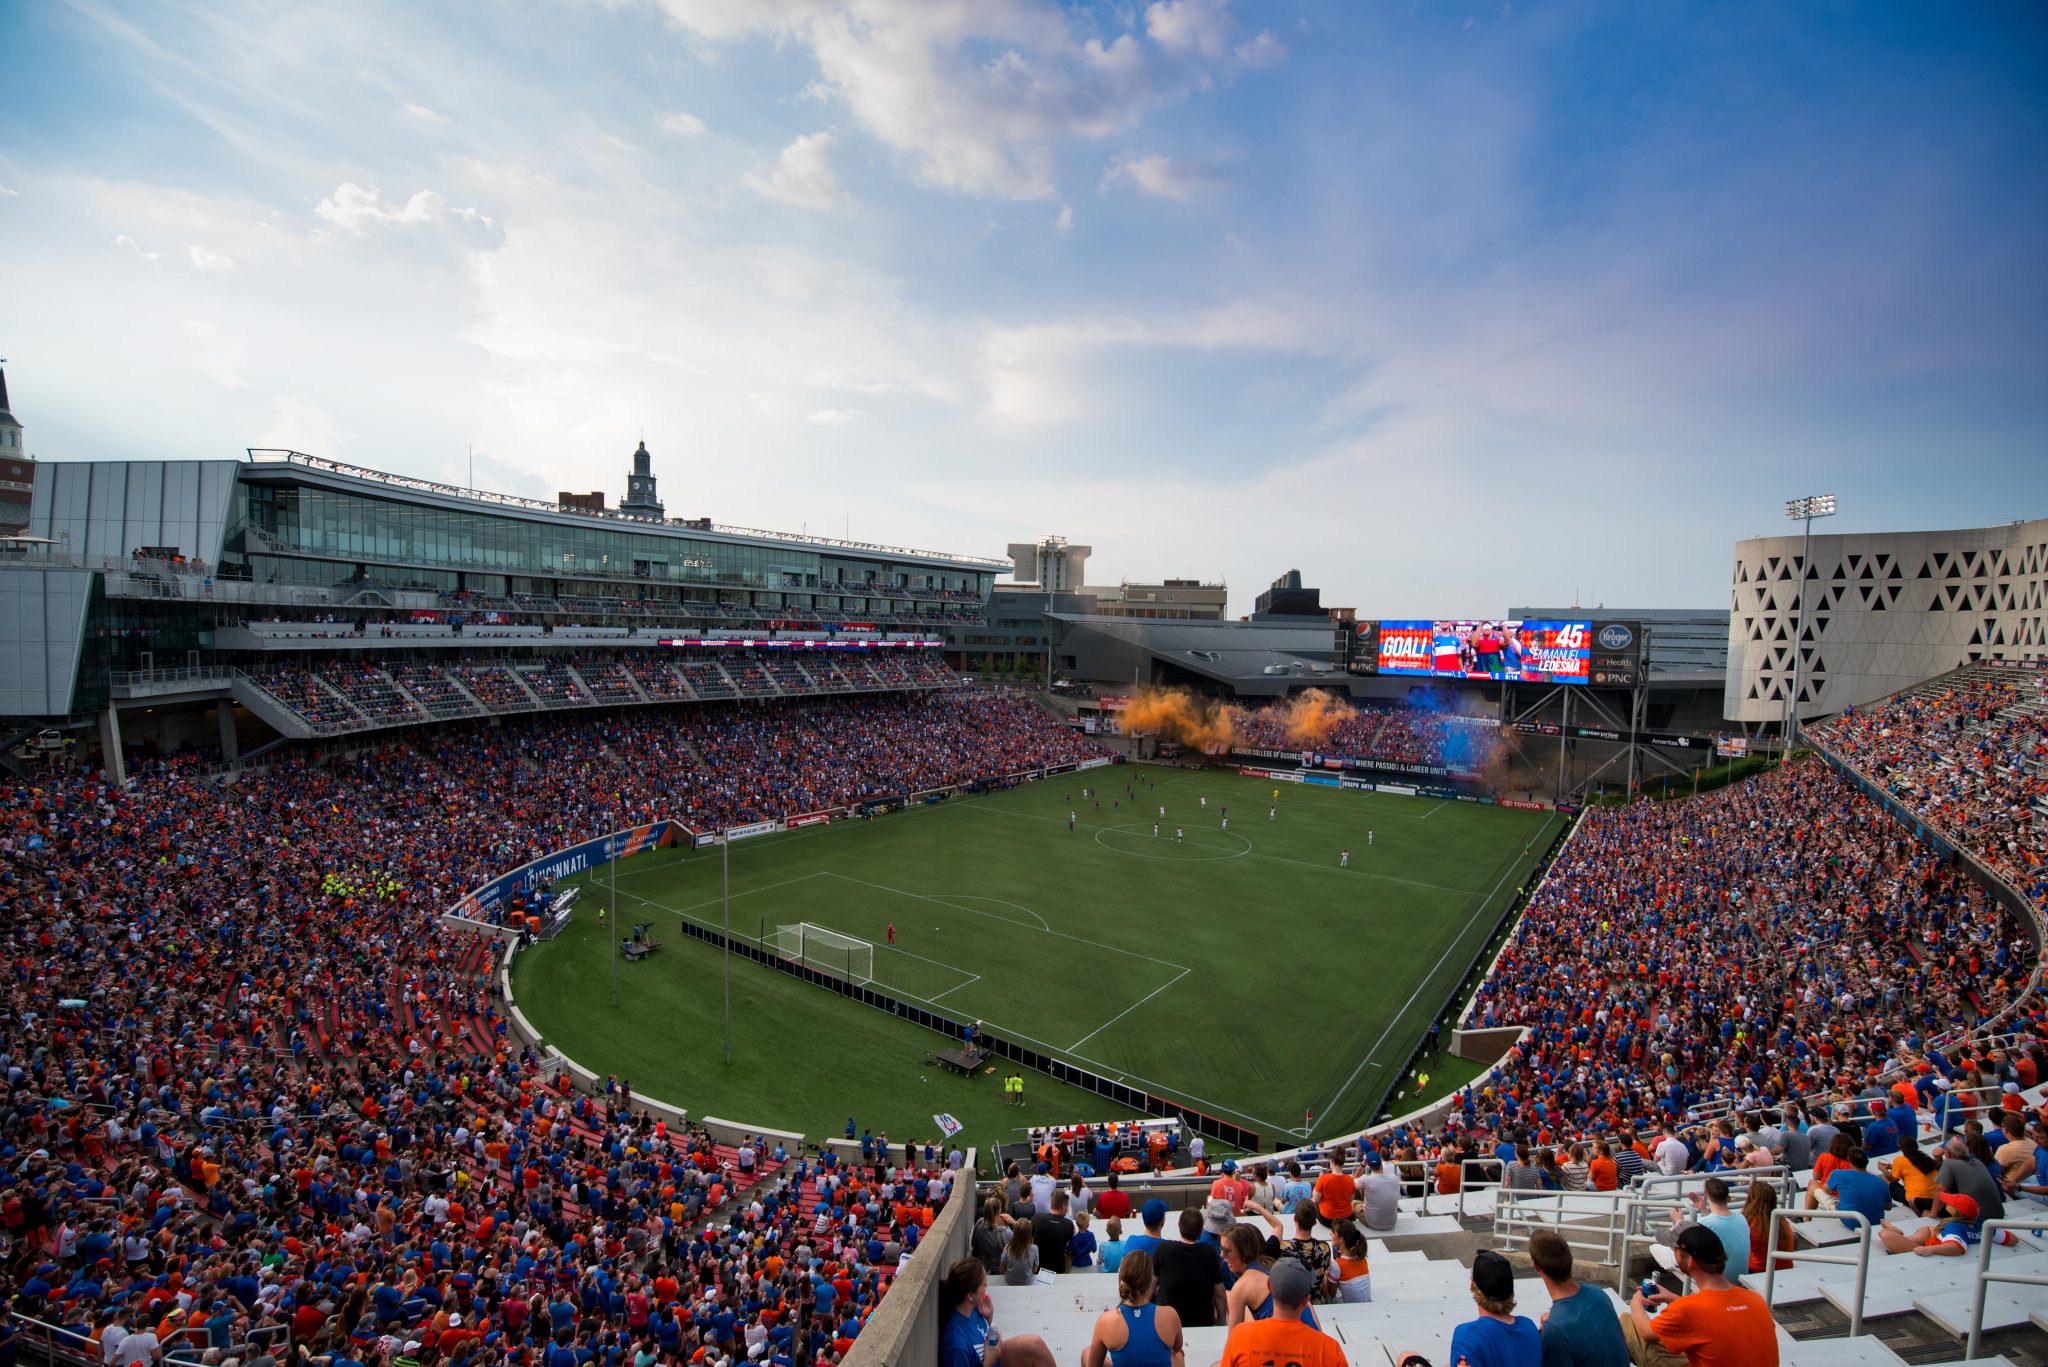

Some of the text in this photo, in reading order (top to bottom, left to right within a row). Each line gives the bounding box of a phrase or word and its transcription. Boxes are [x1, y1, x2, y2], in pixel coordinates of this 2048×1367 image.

[1555, 624, 1585, 648] 45
[1602, 628, 1629, 647] Kroger
[1382, 636, 1428, 658] GOAL!
[1532, 648, 1580, 661] EMMANUEL
[1358, 663, 1374, 671] PNC
[1538, 659, 1580, 673] LEDESMA
[1606, 658, 1632, 667] Health
[1607, 673, 1632, 683] PNC
[1581, 730, 1619, 738] enterprise
[1651, 738, 1678, 746] Ameritas
[1251, 749, 1273, 758] COLLEGE
[1280, 751, 1304, 761] BUSINESS
[1355, 759, 1375, 769] WHERE
[1375, 761, 1399, 771] PASSION
[1400, 763, 1406, 771] &
[1406, 763, 1429, 774] CAREER
[1429, 767, 1448, 776] UNITE
[1342, 780, 1359, 789] JOSEPH
[1513, 801, 1540, 809] TOYOTA
[613, 830, 658, 849] Health Carousel
